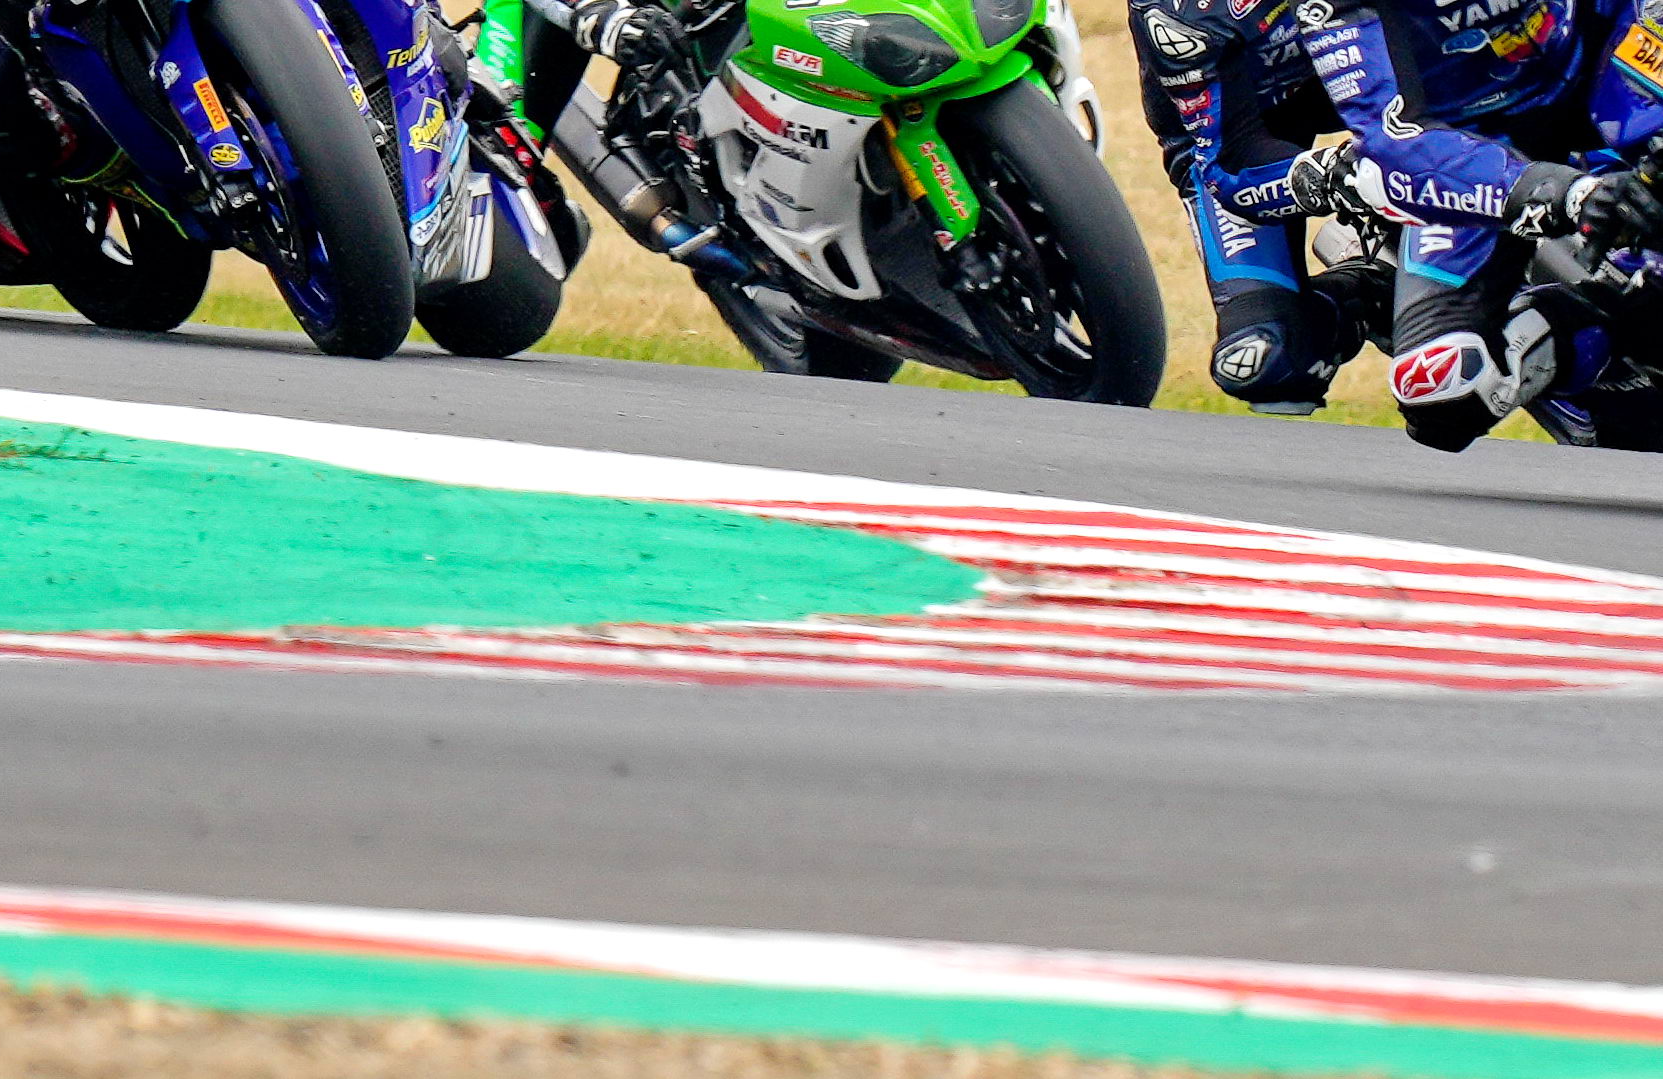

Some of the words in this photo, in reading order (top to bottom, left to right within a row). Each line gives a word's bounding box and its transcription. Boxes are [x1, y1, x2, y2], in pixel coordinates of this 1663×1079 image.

[776, 47, 822, 70] EVR
[198, 83, 225, 126] PIRELLI
[1388, 171, 1414, 203] Si
[1417, 179, 1504, 219] Anelli
